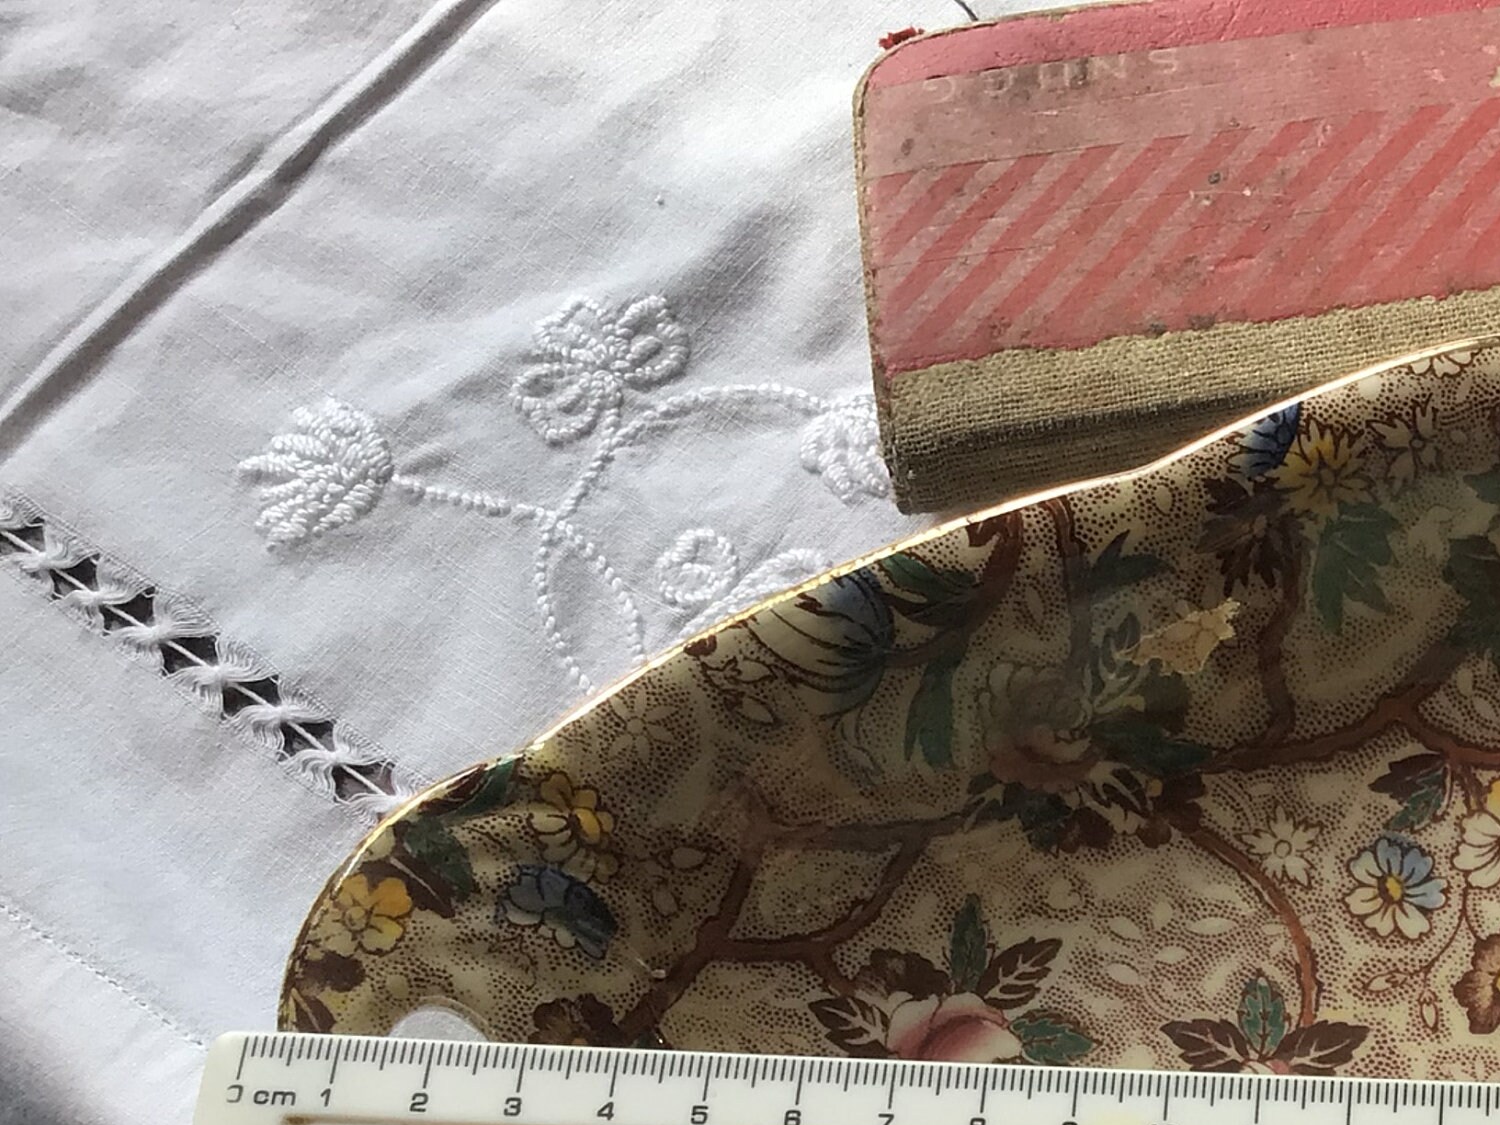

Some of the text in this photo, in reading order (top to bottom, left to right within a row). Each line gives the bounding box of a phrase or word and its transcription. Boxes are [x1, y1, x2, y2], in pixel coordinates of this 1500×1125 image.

[254, 1091, 296, 1105] cm
[321, 1089, 331, 1107] 1
[410, 1093, 428, 1112] 2
[504, 1097, 521, 1116] 3
[597, 1102, 614, 1120] 4
[691, 1106, 708, 1124] 5
